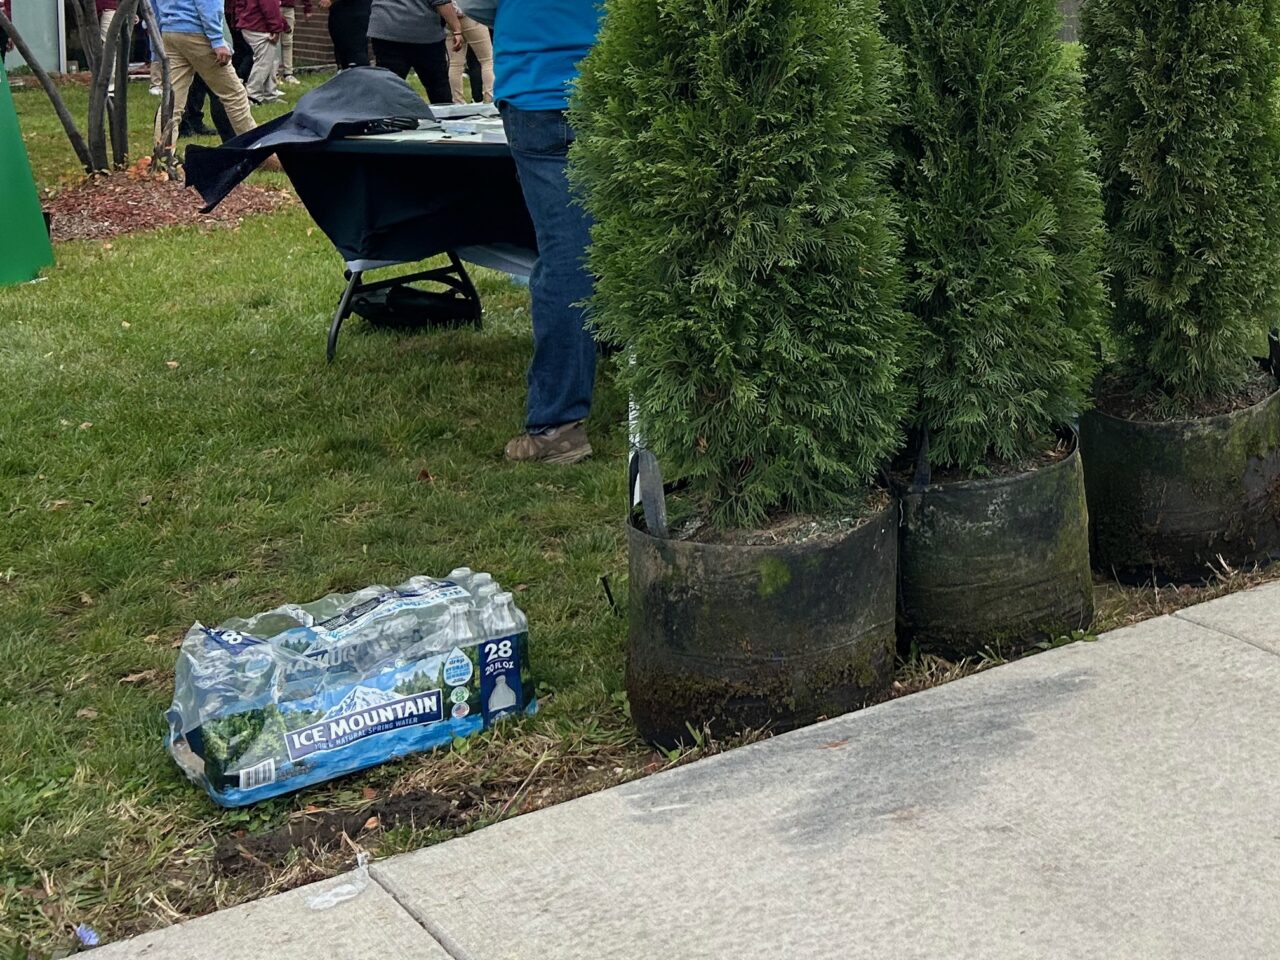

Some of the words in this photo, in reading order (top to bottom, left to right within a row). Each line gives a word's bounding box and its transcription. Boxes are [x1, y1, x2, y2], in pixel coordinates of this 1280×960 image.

[484, 640, 513, 664] 28
[485, 665, 495, 676] 20
[495, 661, 502, 670] FL
[503, 660, 514, 669] OZ
[291, 726, 327, 750] ICE
[330, 695, 438, 740] MOUNTAIN
[336, 731, 366, 745] NATURAL
[368, 722, 394, 734] SPRING
[396, 716, 418, 728] WATER
